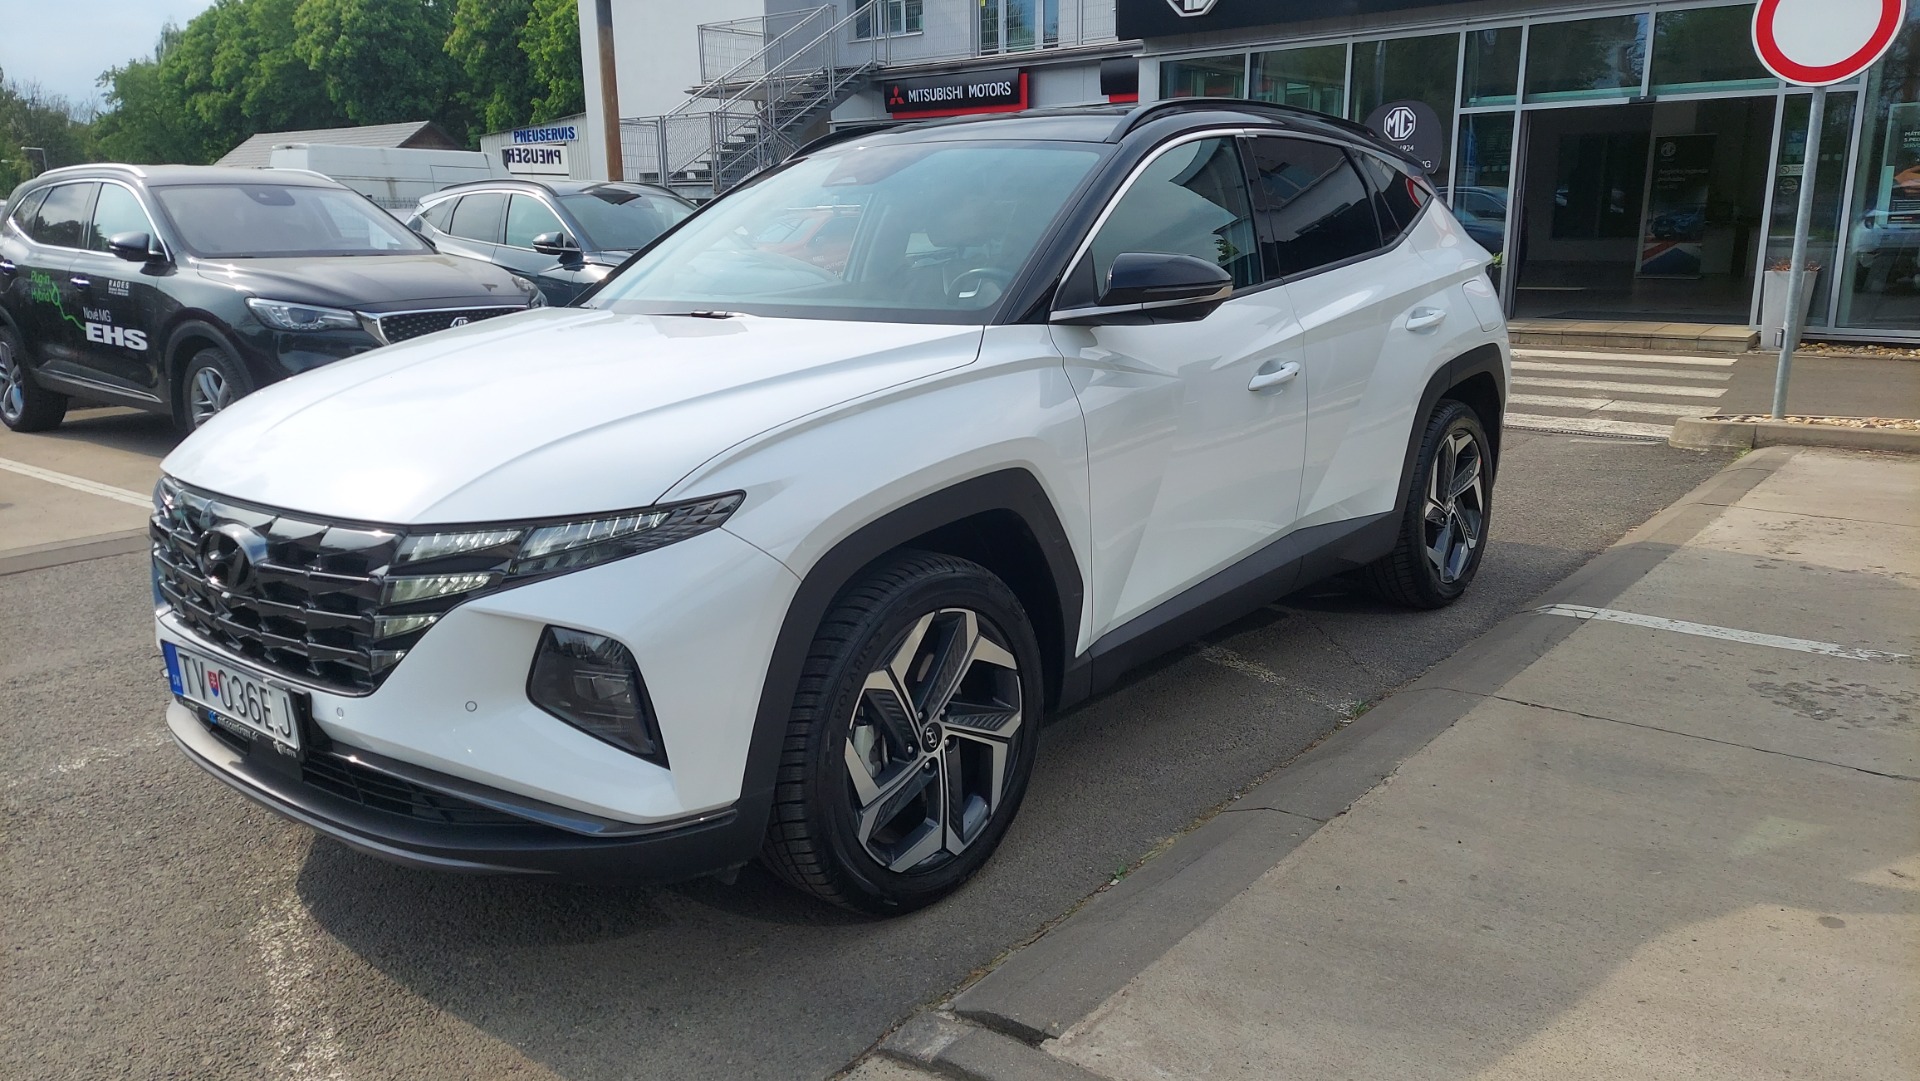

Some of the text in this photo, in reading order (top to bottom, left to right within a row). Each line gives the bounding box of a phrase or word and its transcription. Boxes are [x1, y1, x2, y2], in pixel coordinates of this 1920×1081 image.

[908, 81, 1012, 102] MITSUBISHI MOTORS
[513, 126, 576, 143] PNEUSERVIS
[1386, 108, 1414, 138] MG
[83, 306, 112, 322] Nové MG
[85, 321, 148, 351] EHS
[178, 652, 206, 700] TV
